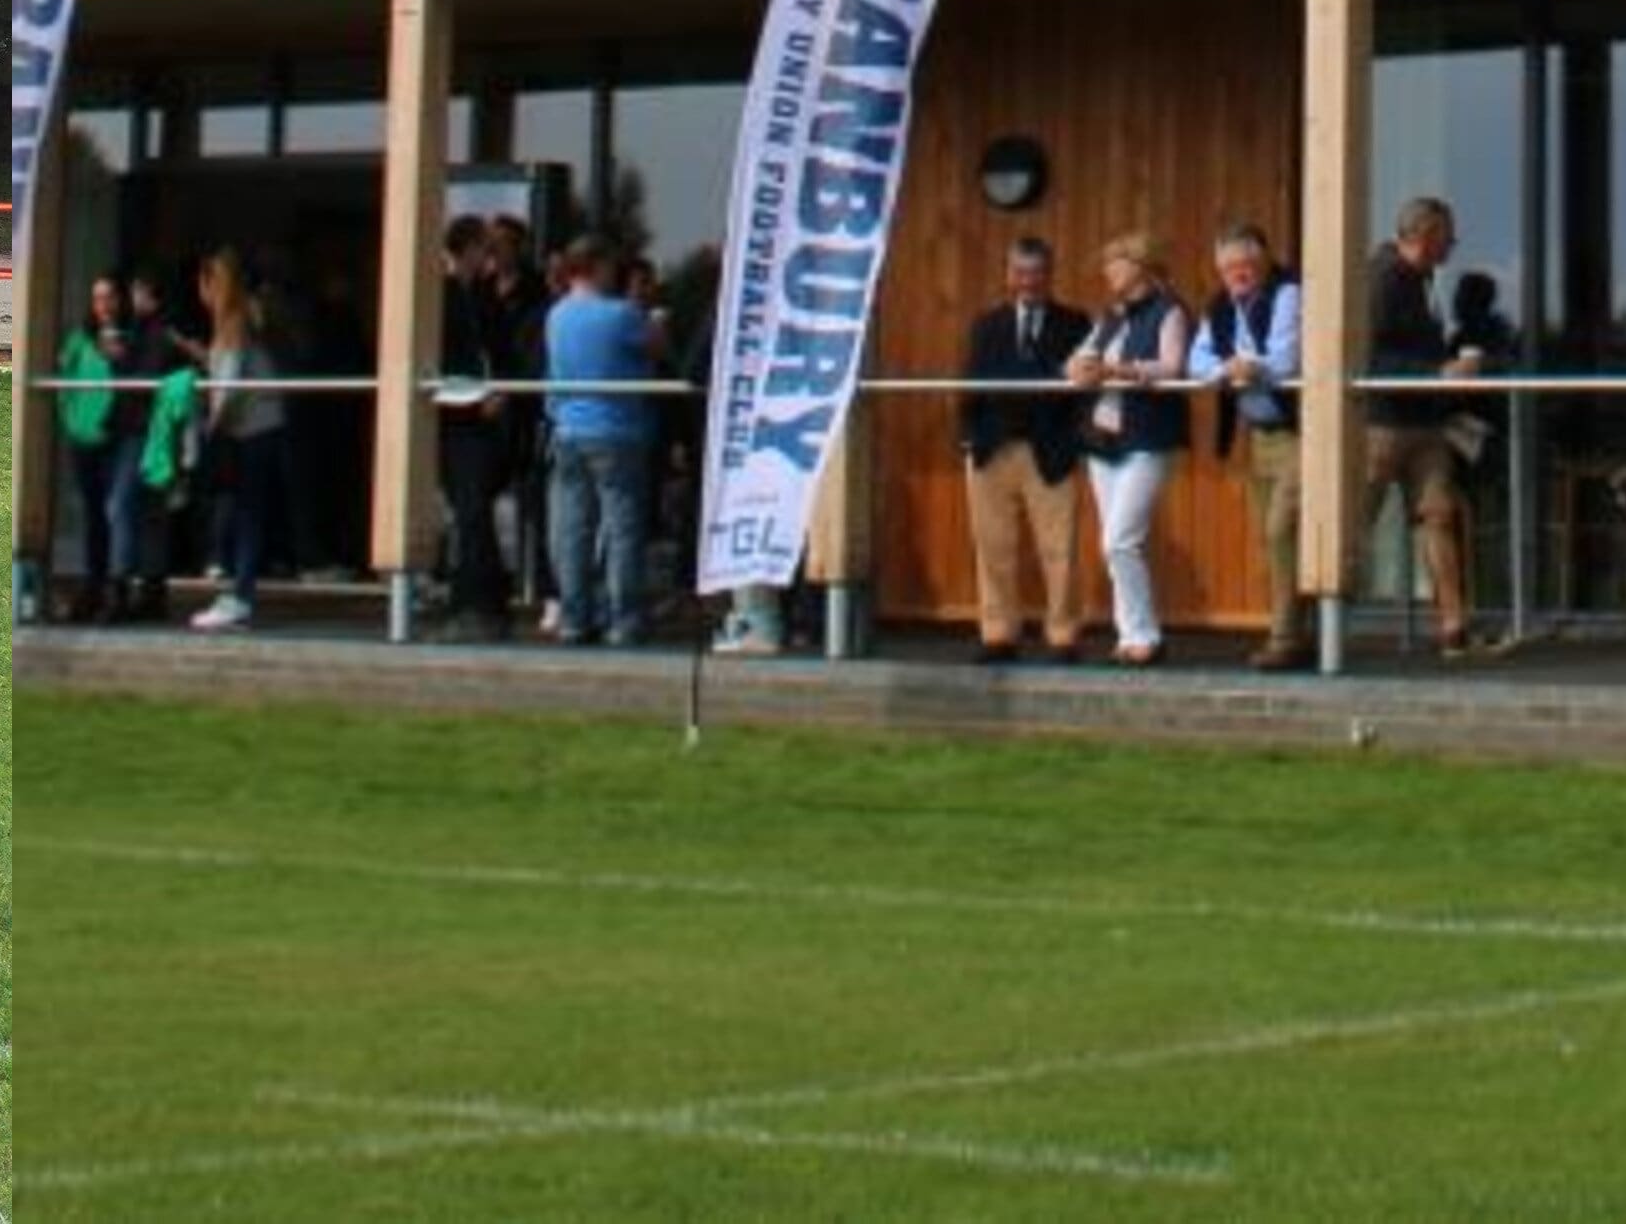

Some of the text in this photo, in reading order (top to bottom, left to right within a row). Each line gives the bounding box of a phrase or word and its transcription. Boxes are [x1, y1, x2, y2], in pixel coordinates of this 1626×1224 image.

[764, 30, 815, 147] UNION
[734, 155, 786, 357] FOOTBALL
[721, 375, 756, 469] CLUB
